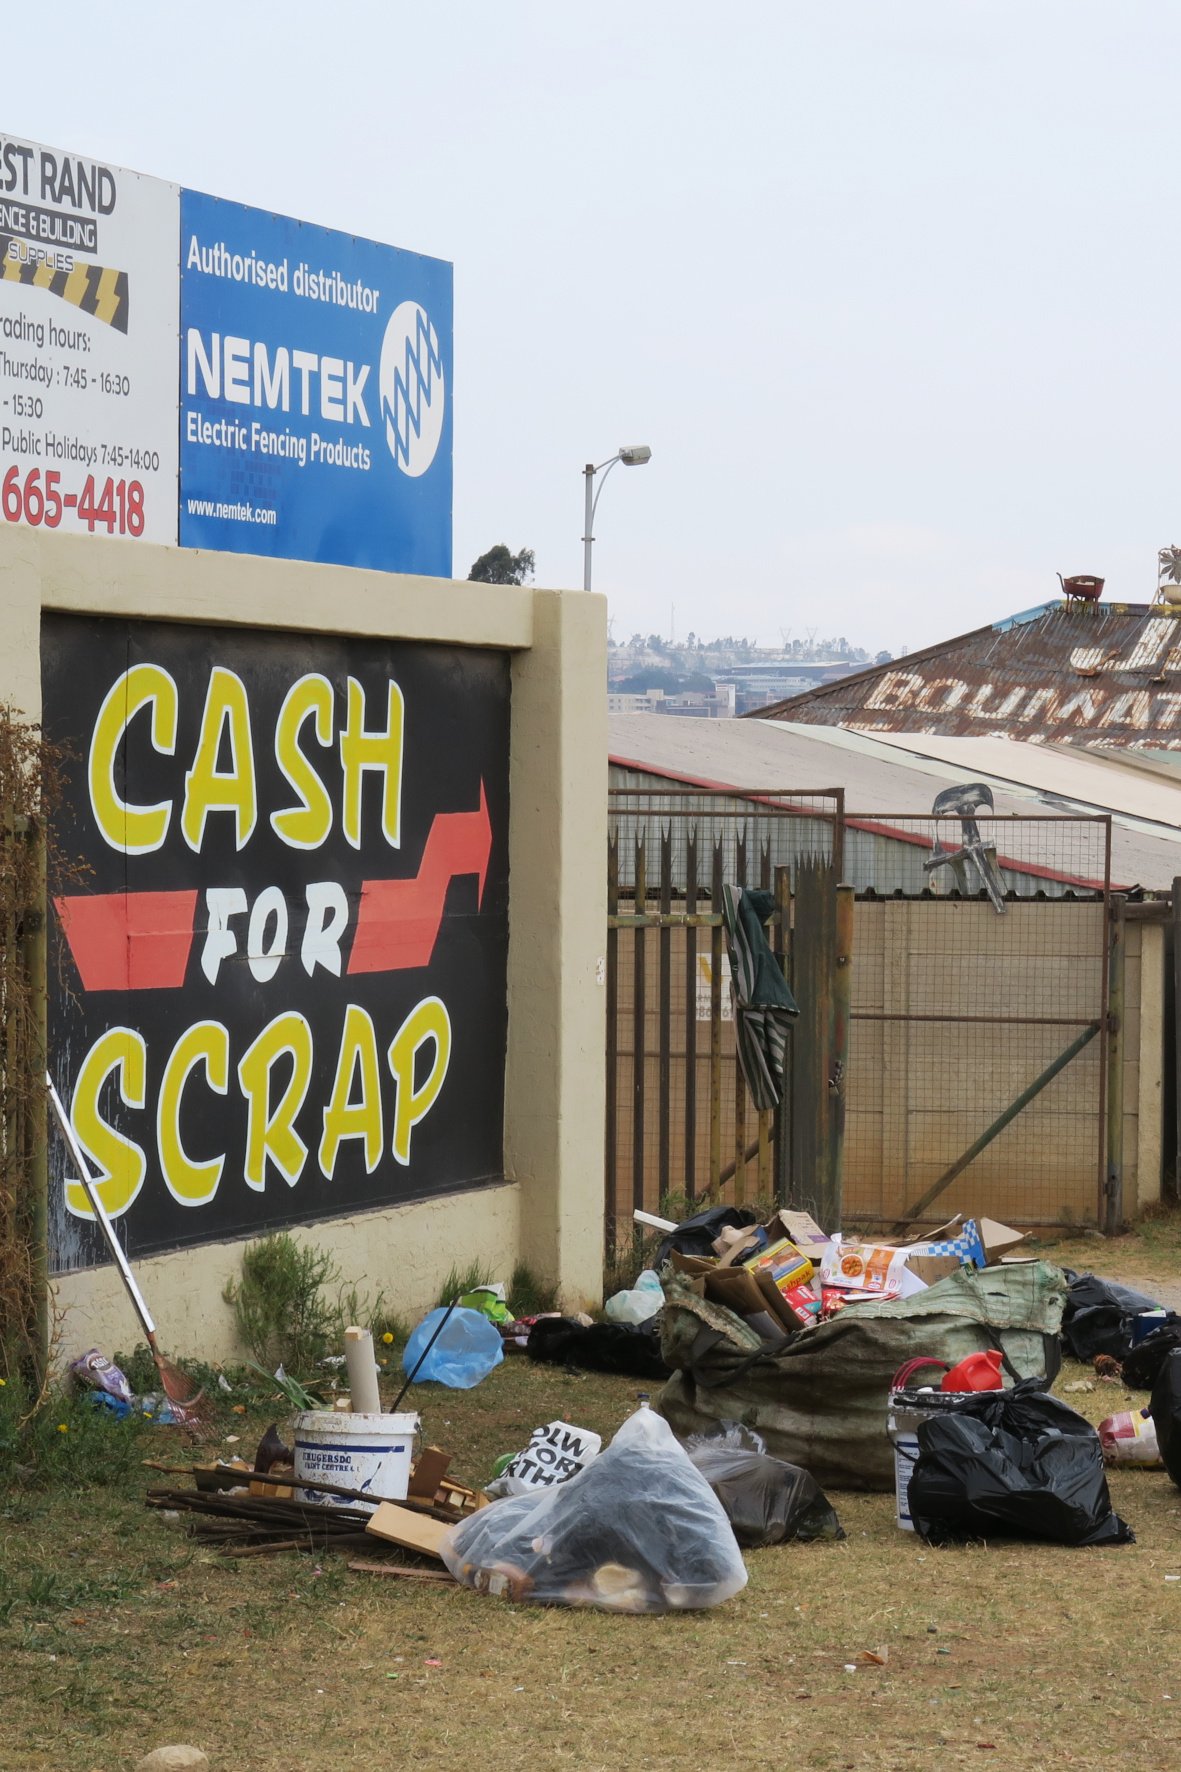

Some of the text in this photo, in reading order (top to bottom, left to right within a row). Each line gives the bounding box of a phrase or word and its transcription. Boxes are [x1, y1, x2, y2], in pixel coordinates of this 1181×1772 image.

[40, 151, 117, 216] RAND
[8, 242, 75, 273] SUPPLIES
[29, 211, 37, 236] &
[40, 214, 96, 248] BUILDING
[186, 234, 380, 315] Authorised distributor
[49, 317, 92, 353] hours:
[12, 393, 44, 419] 15:30
[63, 365, 88, 390] 7:45
[100, 371, 131, 397] 16:30
[186, 327, 372, 428] NEMTEK
[2, 426, 160, 472] Public Holidays 7:45-14:00
[186, 411, 371, 471] Electric Fencing Products
[1, 465, 145, 537] 665-4418
[187, 498, 277, 525] www.nemtek.com
[88, 662, 405, 855] CASH
[200, 881, 350, 986] FOR
[64, 995, 452, 1222] SCRAP
